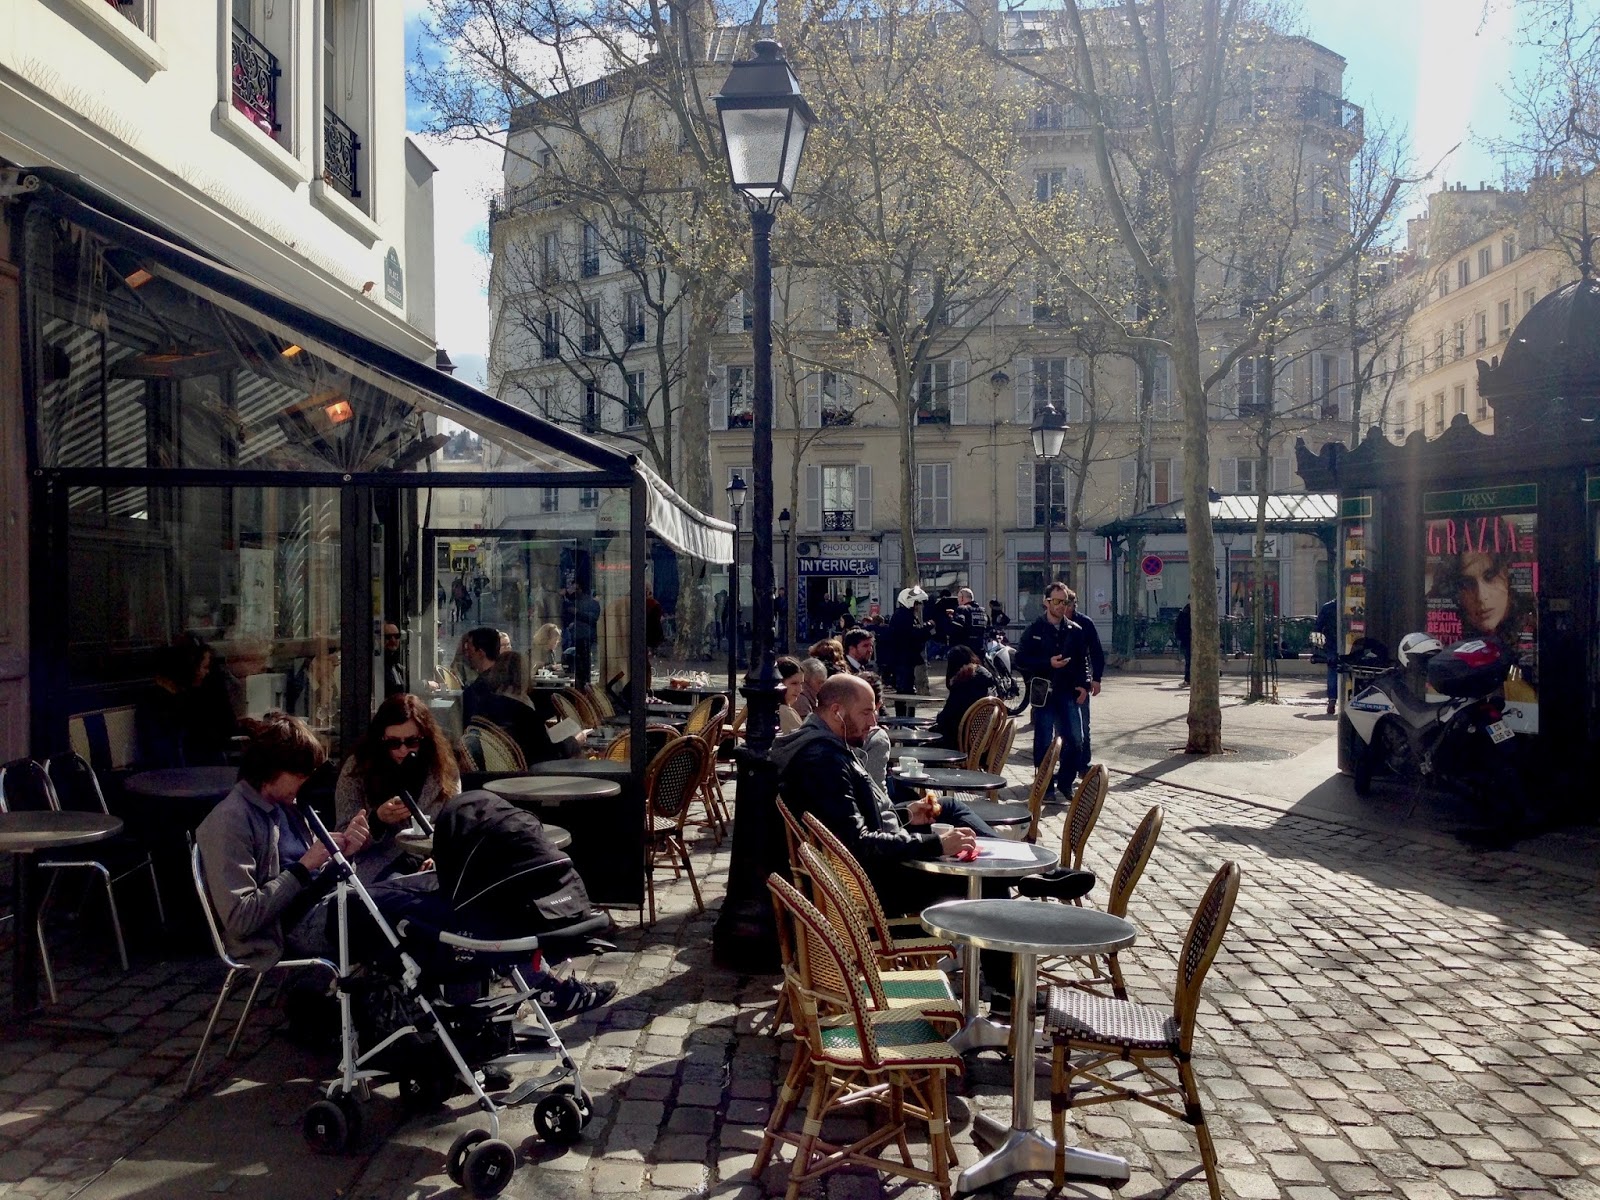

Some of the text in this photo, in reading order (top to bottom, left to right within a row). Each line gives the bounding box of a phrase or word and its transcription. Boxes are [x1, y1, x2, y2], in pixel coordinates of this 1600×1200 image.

[1461, 491, 1500, 507] PRESSE
[1428, 516, 1518, 555] GRAZIA
[822, 543, 875, 551] PHOTOCOPIE
[800, 558, 866, 572] INTERNET
[1426, 609, 1458, 621] SPÉCIAL
[1426, 619, 1463, 634] BEAUTÉ
